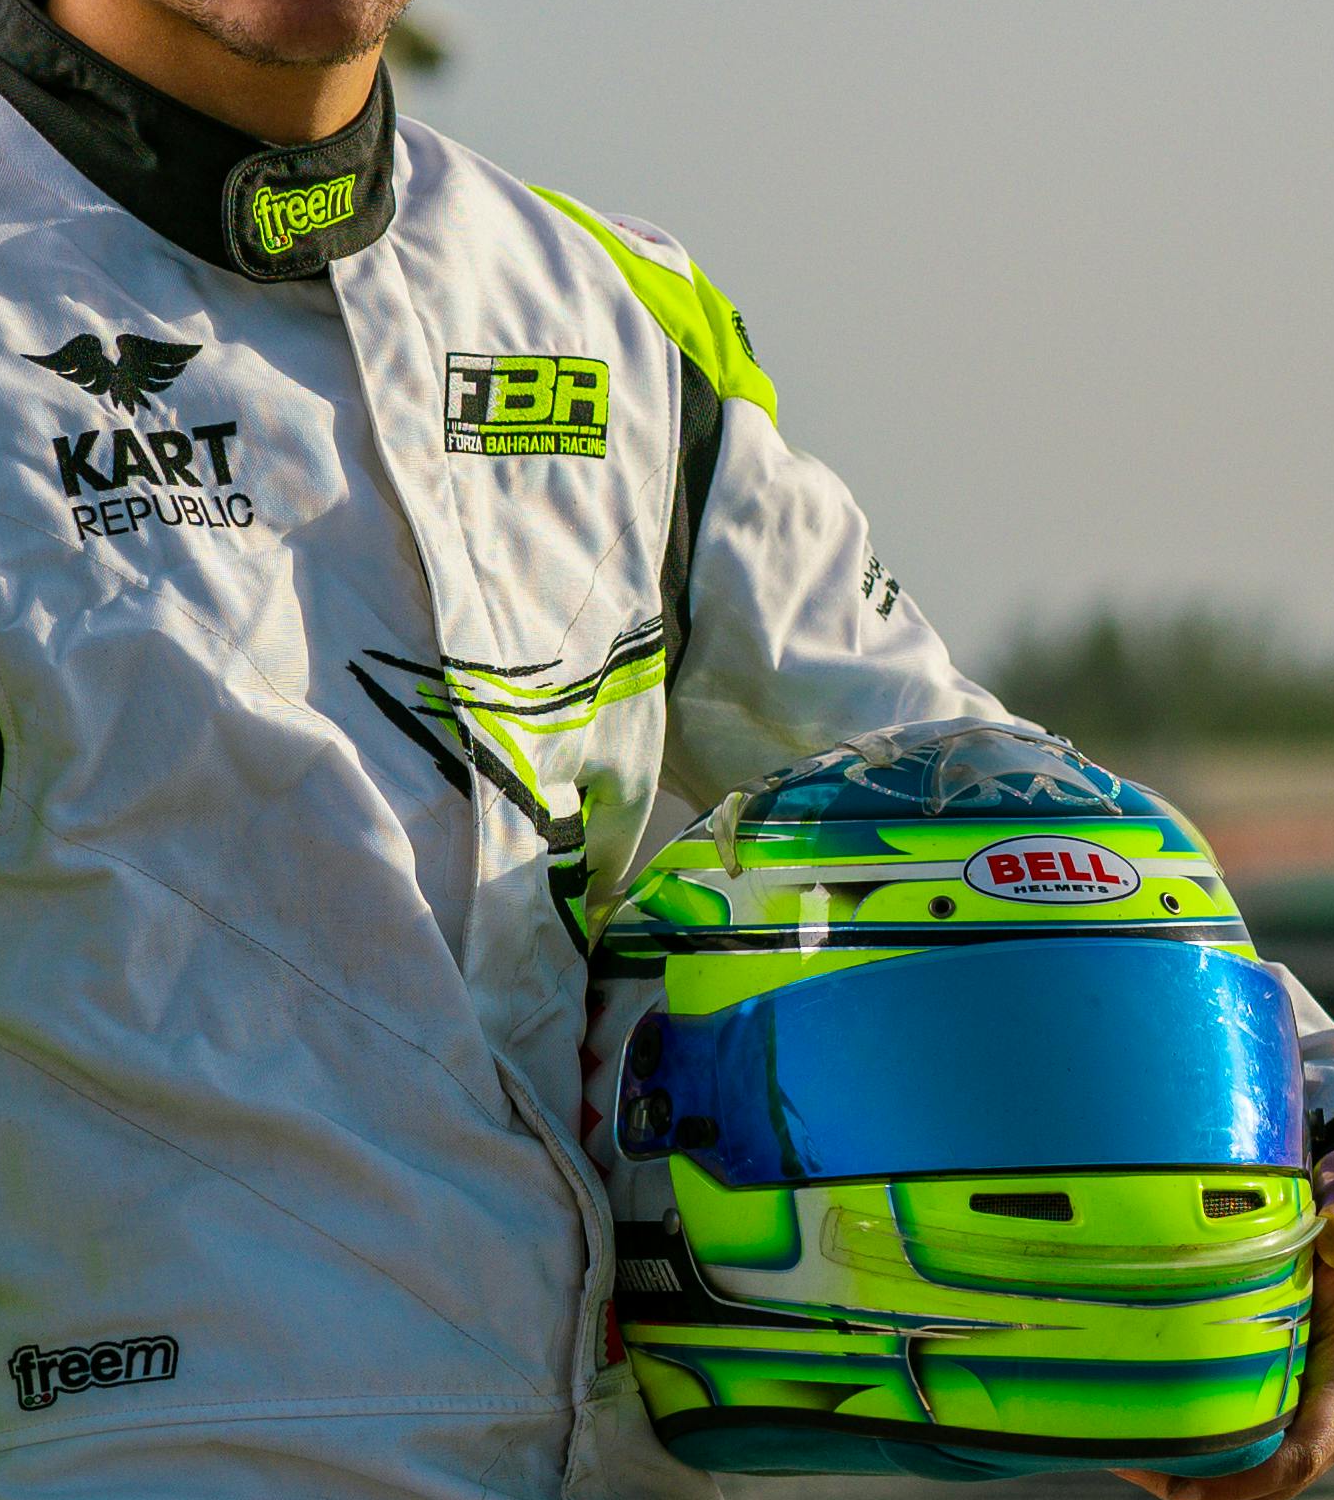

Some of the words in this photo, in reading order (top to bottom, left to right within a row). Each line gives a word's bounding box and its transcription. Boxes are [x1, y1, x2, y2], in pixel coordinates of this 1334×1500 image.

[256, 177, 355, 242] freem
[52, 421, 237, 497] KART
[448, 433, 483, 452] FORZA
[486, 435, 555, 454] BAHRAIN
[559, 434, 607, 456] RACING
[72, 492, 255, 541] REPUBLIC
[985, 851, 1122, 886] BELL
[1013, 884, 1110, 894] HELMETS
[13, 1341, 170, 1397] freem
